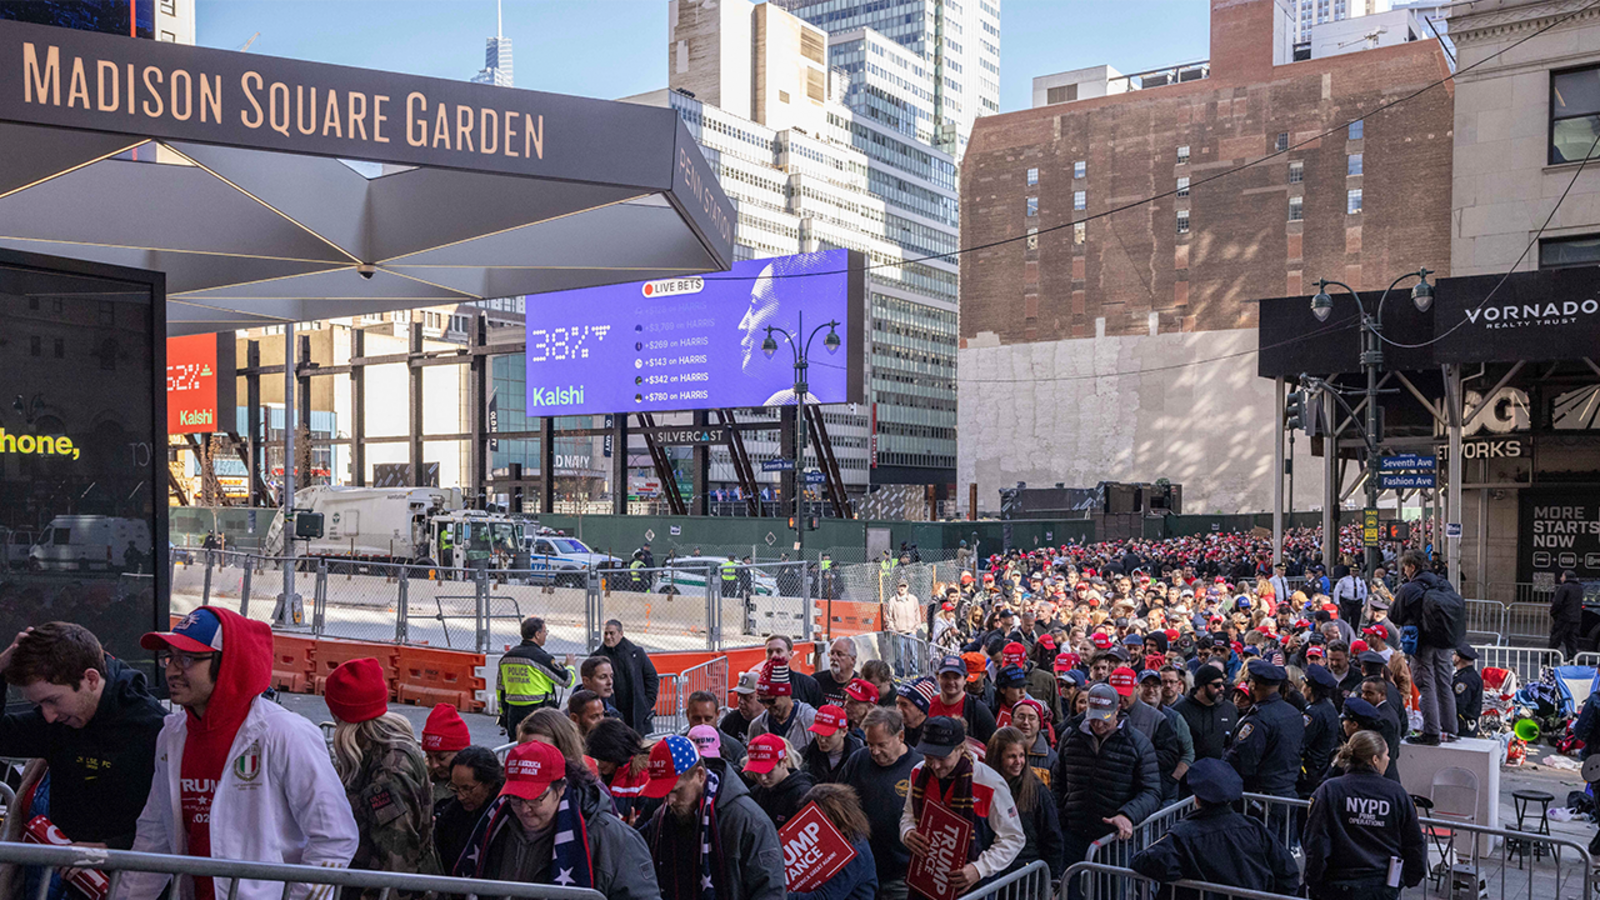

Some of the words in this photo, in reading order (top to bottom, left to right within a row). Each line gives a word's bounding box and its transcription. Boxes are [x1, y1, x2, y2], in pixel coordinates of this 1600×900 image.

[23, 42, 222, 124] MADISON
[240, 71, 390, 143] SQUARE
[406, 91, 544, 160] GARDEN
[679, 147, 703, 203] PENN
[703, 187, 731, 245] STATION
[655, 282, 675, 293] LIVE
[677, 279, 702, 290] BETS
[1465, 299, 1598, 324] VORNADO
[686, 318, 716, 329] HARRIS
[1486, 320, 1530, 329] REALTY
[1536, 317, 1577, 326] TRUST
[533, 325, 589, 362] 38%
[645, 340, 669, 350] +$269
[680, 336, 709, 347] HARRIS
[645, 357, 667, 367] +$143
[679, 354, 707, 365] HARRIS
[645, 375, 669, 385] +$342
[680, 372, 709, 382] HARRIS
[533, 385, 584, 407] Kalshi
[645, 392, 668, 402] +$780
[680, 390, 709, 400] HARRIS
[180, 409, 213, 426] Kalshi
[763, 462, 782, 470] Seventh
[1383, 458, 1416, 467] Seventh
[1417, 458, 1433, 467] Ave
[1383, 476, 1415, 486] Fashion
[1416, 477, 1432, 485] Ave
[1534, 506, 1585, 519] MORE
[1533, 520, 1600, 534] STARTS
[1533, 534, 1576, 548] NOW
[508, 666, 529, 677] POLICE
[1346, 797, 1390, 816] NYPD
[1348, 817, 1385, 827] OPERATIONS
[924, 830, 942, 875] VANCE
[932, 824, 960, 896] TRUMP
